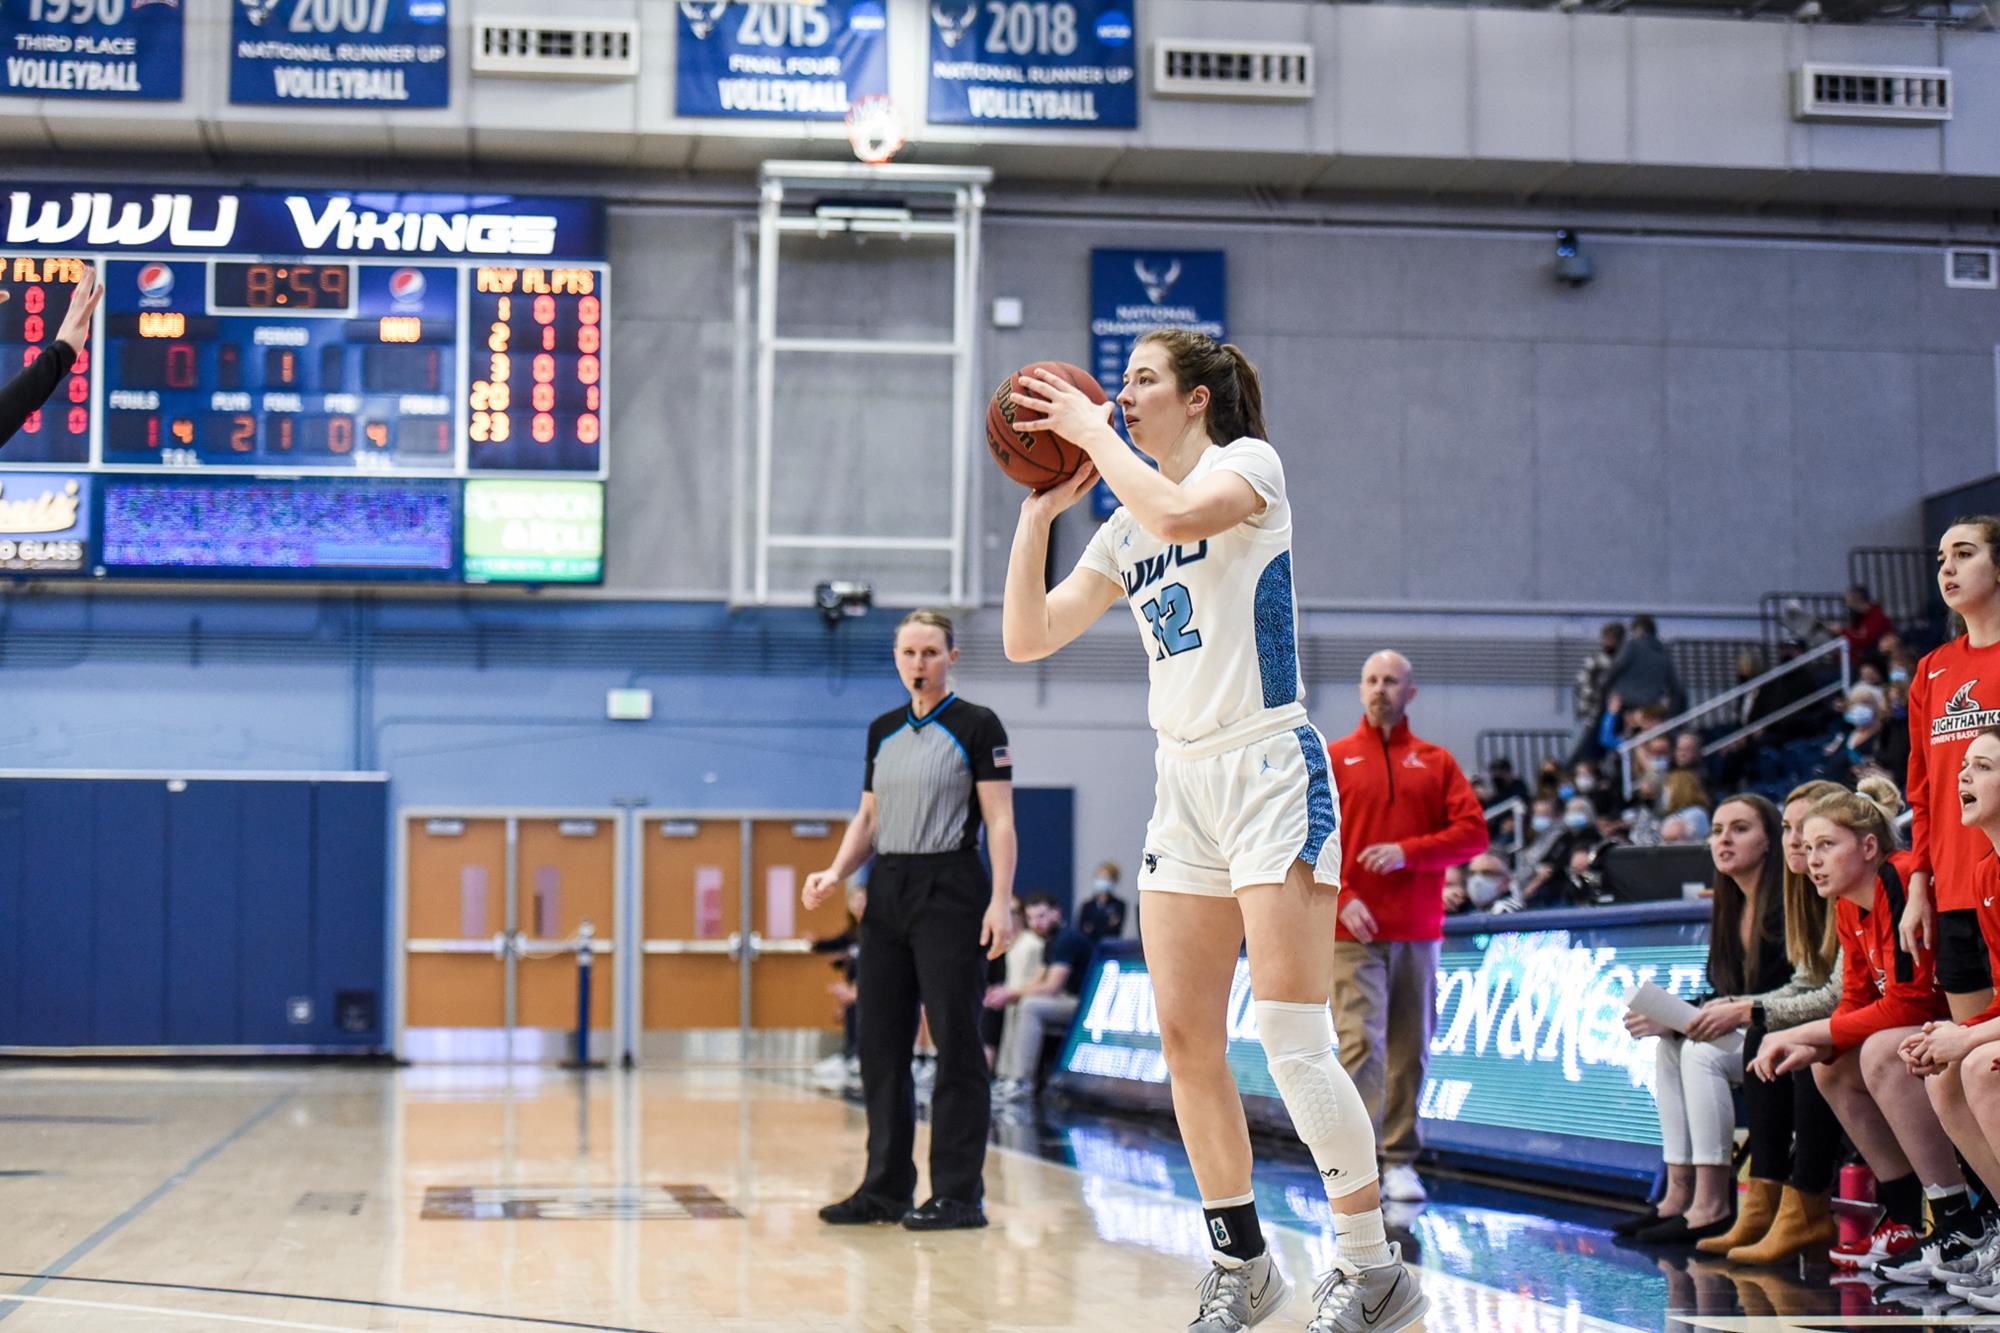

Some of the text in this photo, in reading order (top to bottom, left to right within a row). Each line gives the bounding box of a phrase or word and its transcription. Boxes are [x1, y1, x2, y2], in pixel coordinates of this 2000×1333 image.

[15, 34, 136, 54] THIRD PLACE
[985, 3, 1078, 56] 2018
[238, 41, 445, 63] NATIONAL RUNNER UP
[729, 54, 841, 75] FINAL FOUR
[7, 56, 141, 91] VOLLEYBALL
[273, 66, 409, 100] VOLLEYBALL
[933, 61, 1133, 84] NATIONAL RUNNER UP
[718, 78, 851, 112] VOLLEYBALL
[967, 86, 1099, 120] VOLLEYBALL
[7, 191, 239, 247] WWU
[247, 266, 347, 308] 8:59
[18, 540, 83, 561] GLASS
[1140, 582, 1202, 661] 12
